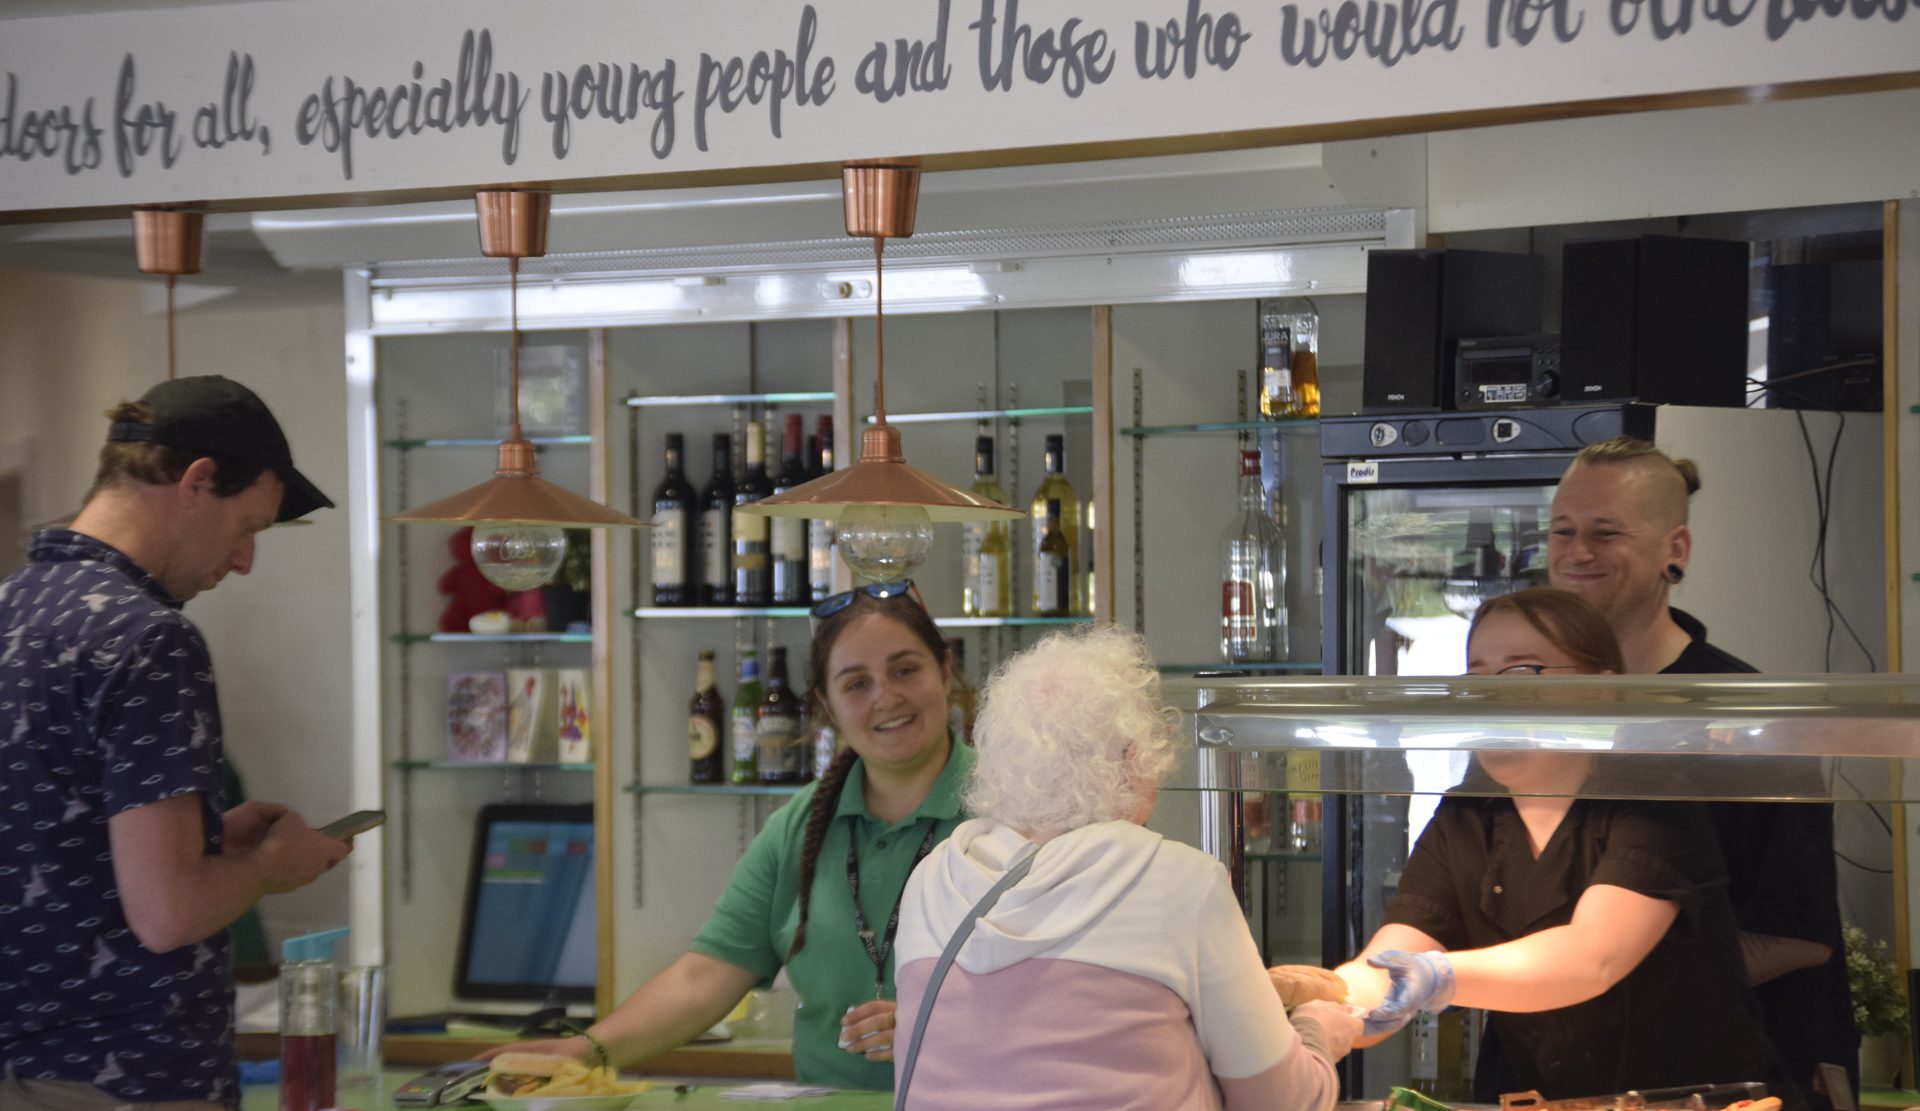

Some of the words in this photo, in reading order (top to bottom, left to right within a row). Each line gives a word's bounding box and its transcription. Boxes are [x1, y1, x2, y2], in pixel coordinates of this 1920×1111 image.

[114, 52, 186, 178] for
[192, 50, 270, 156] all,
[296, 28, 530, 180] especially
[542, 59, 684, 160] young
[694, 4, 836, 153] people
[855, 0, 952, 104] and
[968, 0, 1116, 99] those
[1135, 0, 1252, 80] who
